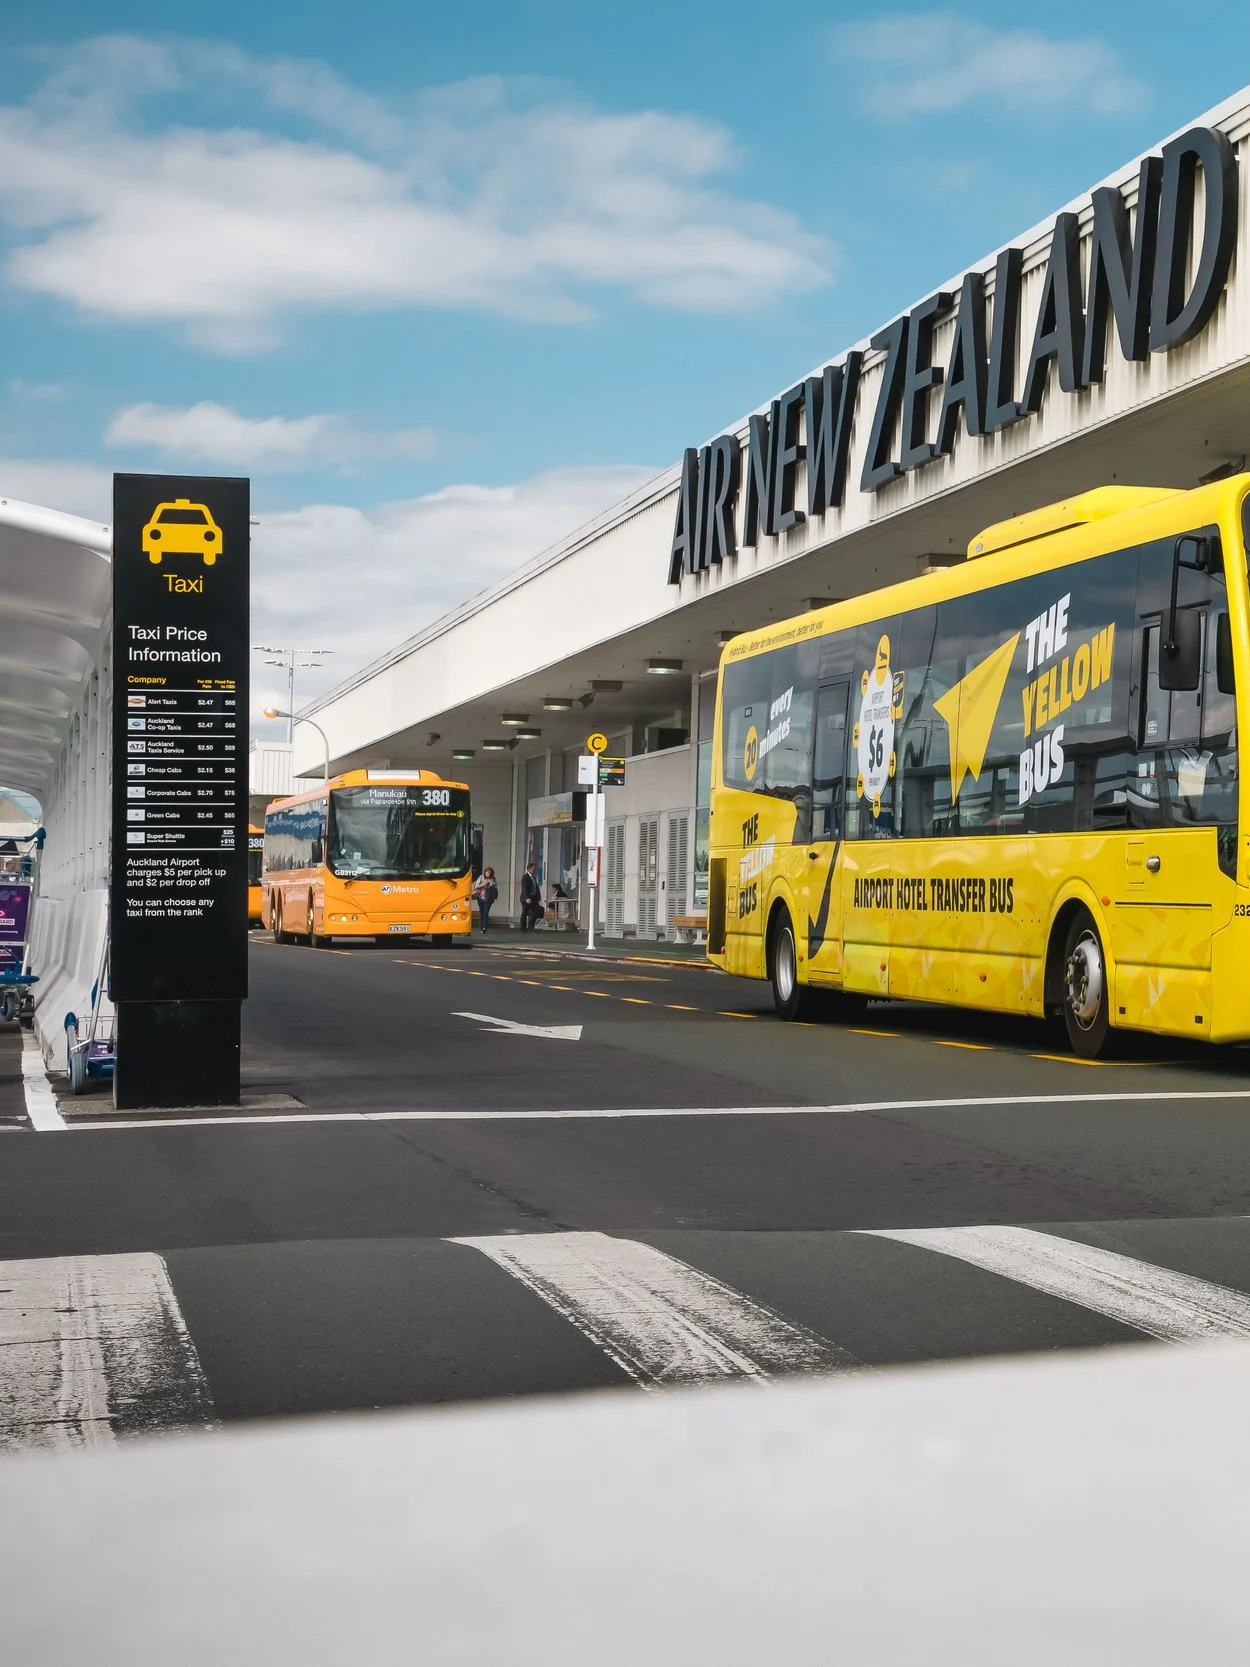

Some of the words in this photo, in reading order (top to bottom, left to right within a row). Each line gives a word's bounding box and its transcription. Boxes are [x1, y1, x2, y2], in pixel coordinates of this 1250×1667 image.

[667, 434, 740, 585] AIR
[743, 351, 863, 548] NEW
[861, 126, 1236, 493] ZEALAND
[163, 574, 203, 593] Taxi
[128, 625, 160, 640] Taxi
[166, 626, 208, 641] Price
[1025, 592, 1071, 674] THE
[129, 647, 221, 662] Information
[127, 675, 167, 685] Company
[1022, 622, 1116, 738] YELLOW
[771, 686, 794, 721] every
[592, 736, 602, 750] C
[746, 739, 756, 770] 20
[759, 716, 791, 759] minutes
[868, 724, 884, 773] $6
[1018, 724, 1065, 806] BUS
[369, 789, 407, 798] Manukau
[422, 789, 450, 806] 380
[742, 812, 759, 849] THE
[126, 858, 168, 866] Auckland
[170, 858, 200, 867] Airport
[126, 868, 162, 877] charges
[164, 867, 175, 876] $5
[177, 869, 192, 877] per
[194, 868, 213, 877] pick
[214, 869, 226, 877] up
[126, 878, 144, 886] and
[146, 877, 157, 887] $2
[159, 879, 174, 887] per
[176, 878, 196, 887] drop
[198, 878, 211, 886] off
[126, 898, 143, 906] You
[164, 898, 196, 906] choose
[198, 899, 214, 907] any
[739, 881, 757, 920] BUS
[854, 878, 894, 909] AIRPORT
[896, 878, 928, 910] HOTEL
[930, 878, 986, 913] TRANSFER
[989, 878, 1014, 914] BUS
[126, 908, 143, 917] taxi
[145, 908, 165, 916] from
[167, 908, 182, 916] the
[183, 908, 203, 916] rank
